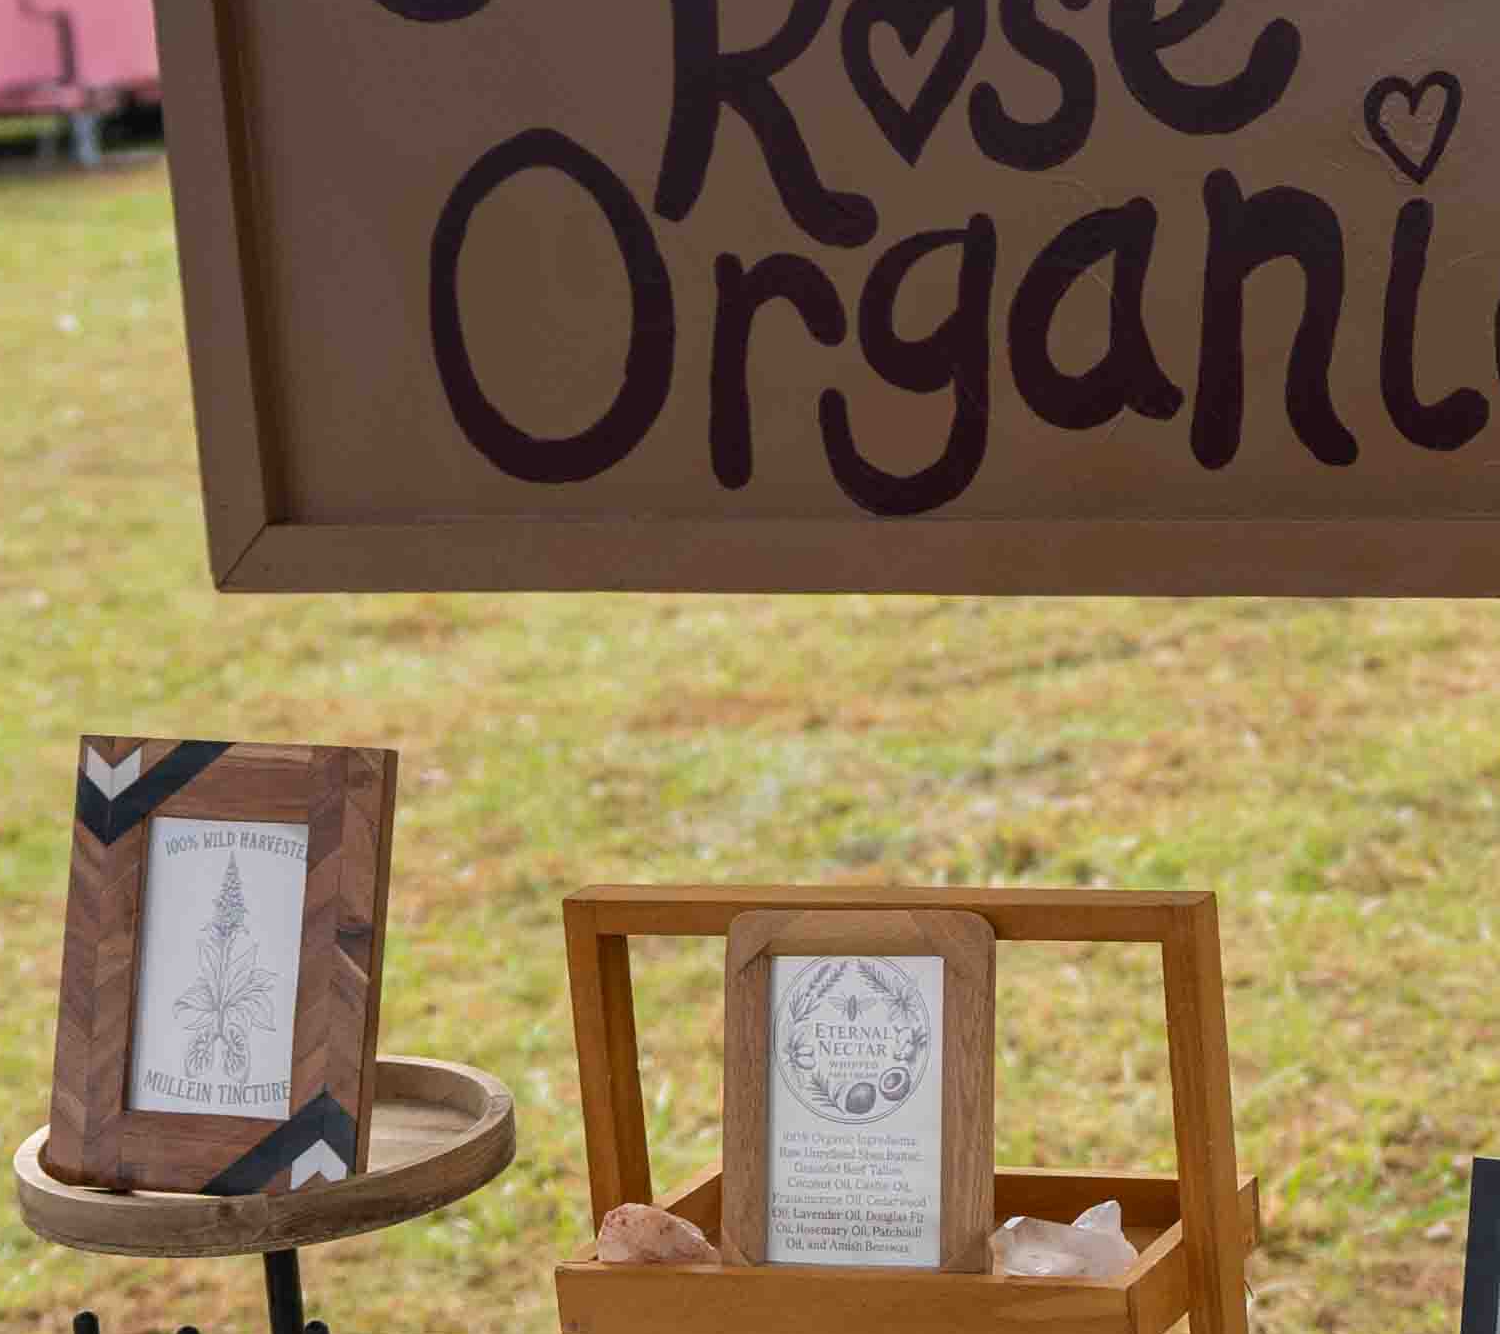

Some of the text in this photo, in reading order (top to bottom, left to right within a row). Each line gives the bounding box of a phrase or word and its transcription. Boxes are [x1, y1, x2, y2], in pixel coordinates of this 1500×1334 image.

[204, 831, 235, 849] WILD
[819, 1040, 888, 1058] NECTAR
[140, 1068, 212, 1105] MULLEIN
[793, 1208, 843, 1221] Lavender
[796, 1223, 848, 1239] Rosemary
